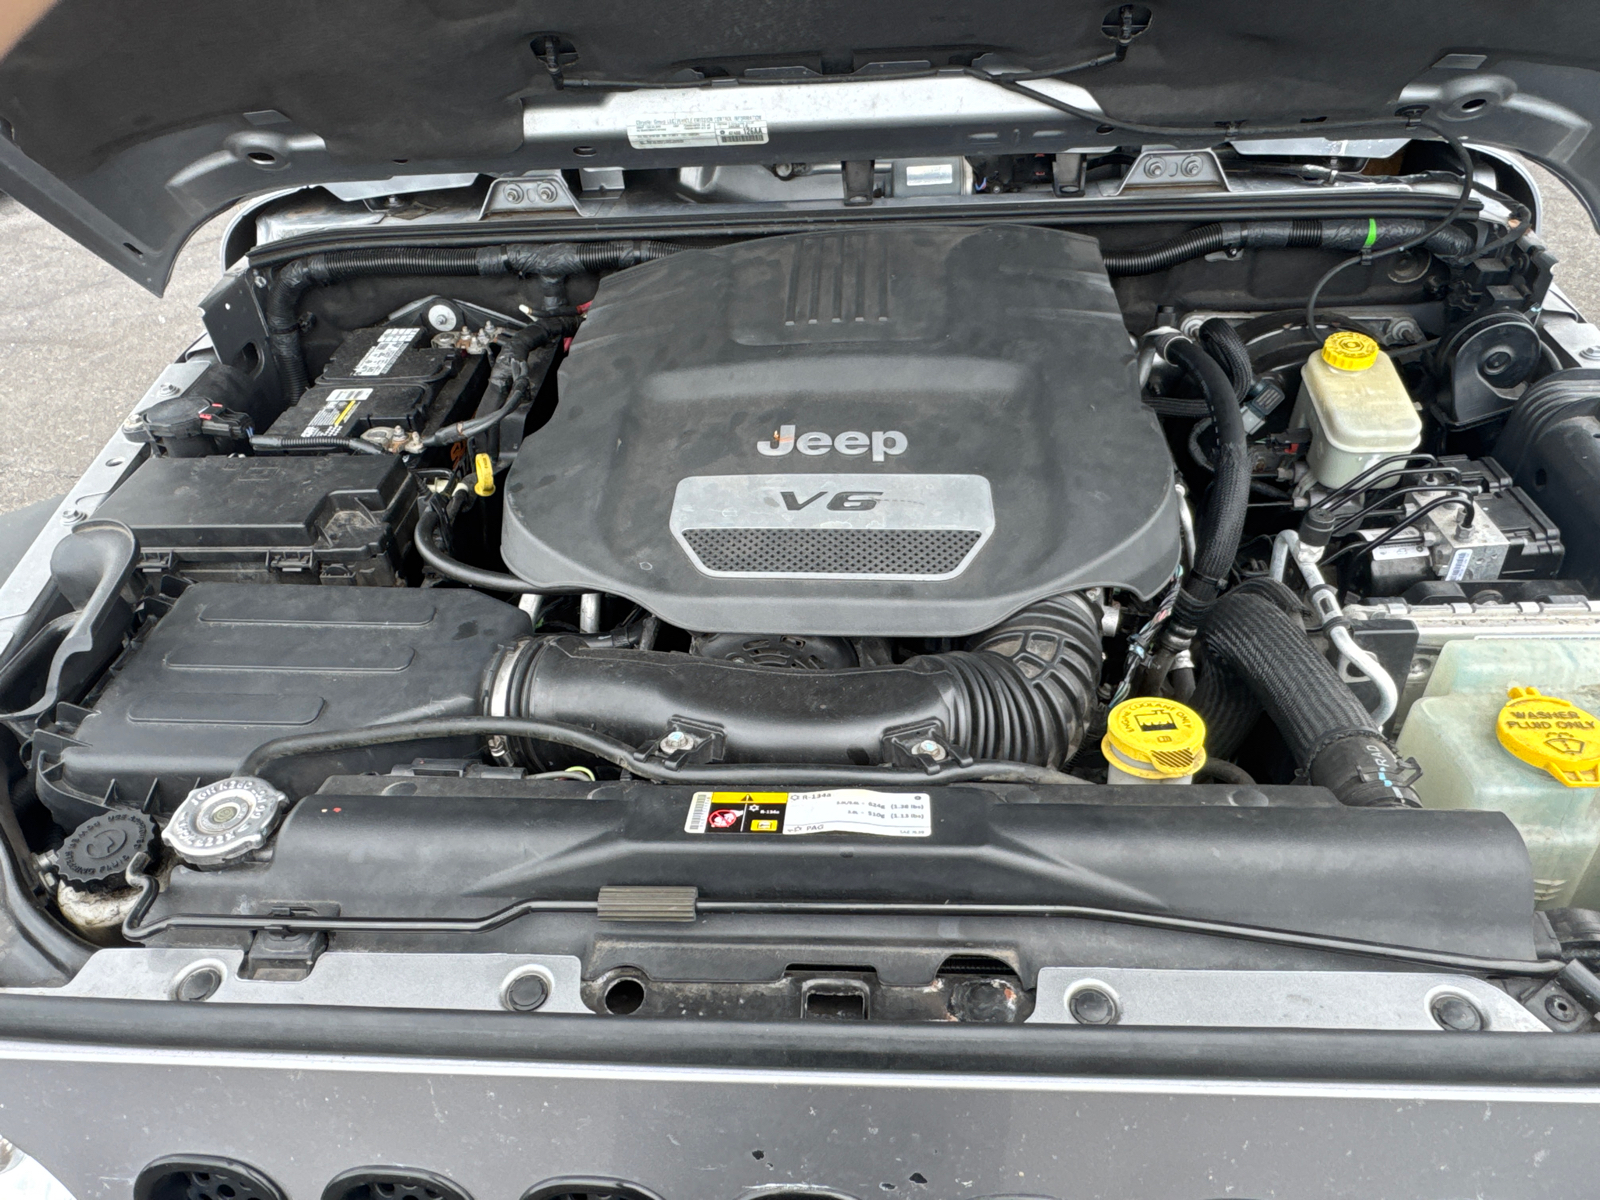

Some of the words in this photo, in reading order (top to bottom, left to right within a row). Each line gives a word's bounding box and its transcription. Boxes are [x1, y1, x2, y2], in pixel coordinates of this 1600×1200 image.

[756, 424, 908, 462] Jeep
[779, 491, 884, 511] V6
[1509, 710, 1581, 720] WASHER
[1505, 720, 1553, 730] FLUID
[1555, 720, 1596, 730] ONLY
[1366, 744, 1391, 768] RAD
[802, 792, 832, 801] R-134a
[868, 801, 886, 810] 624g
[867, 810, 886, 819] 510g
